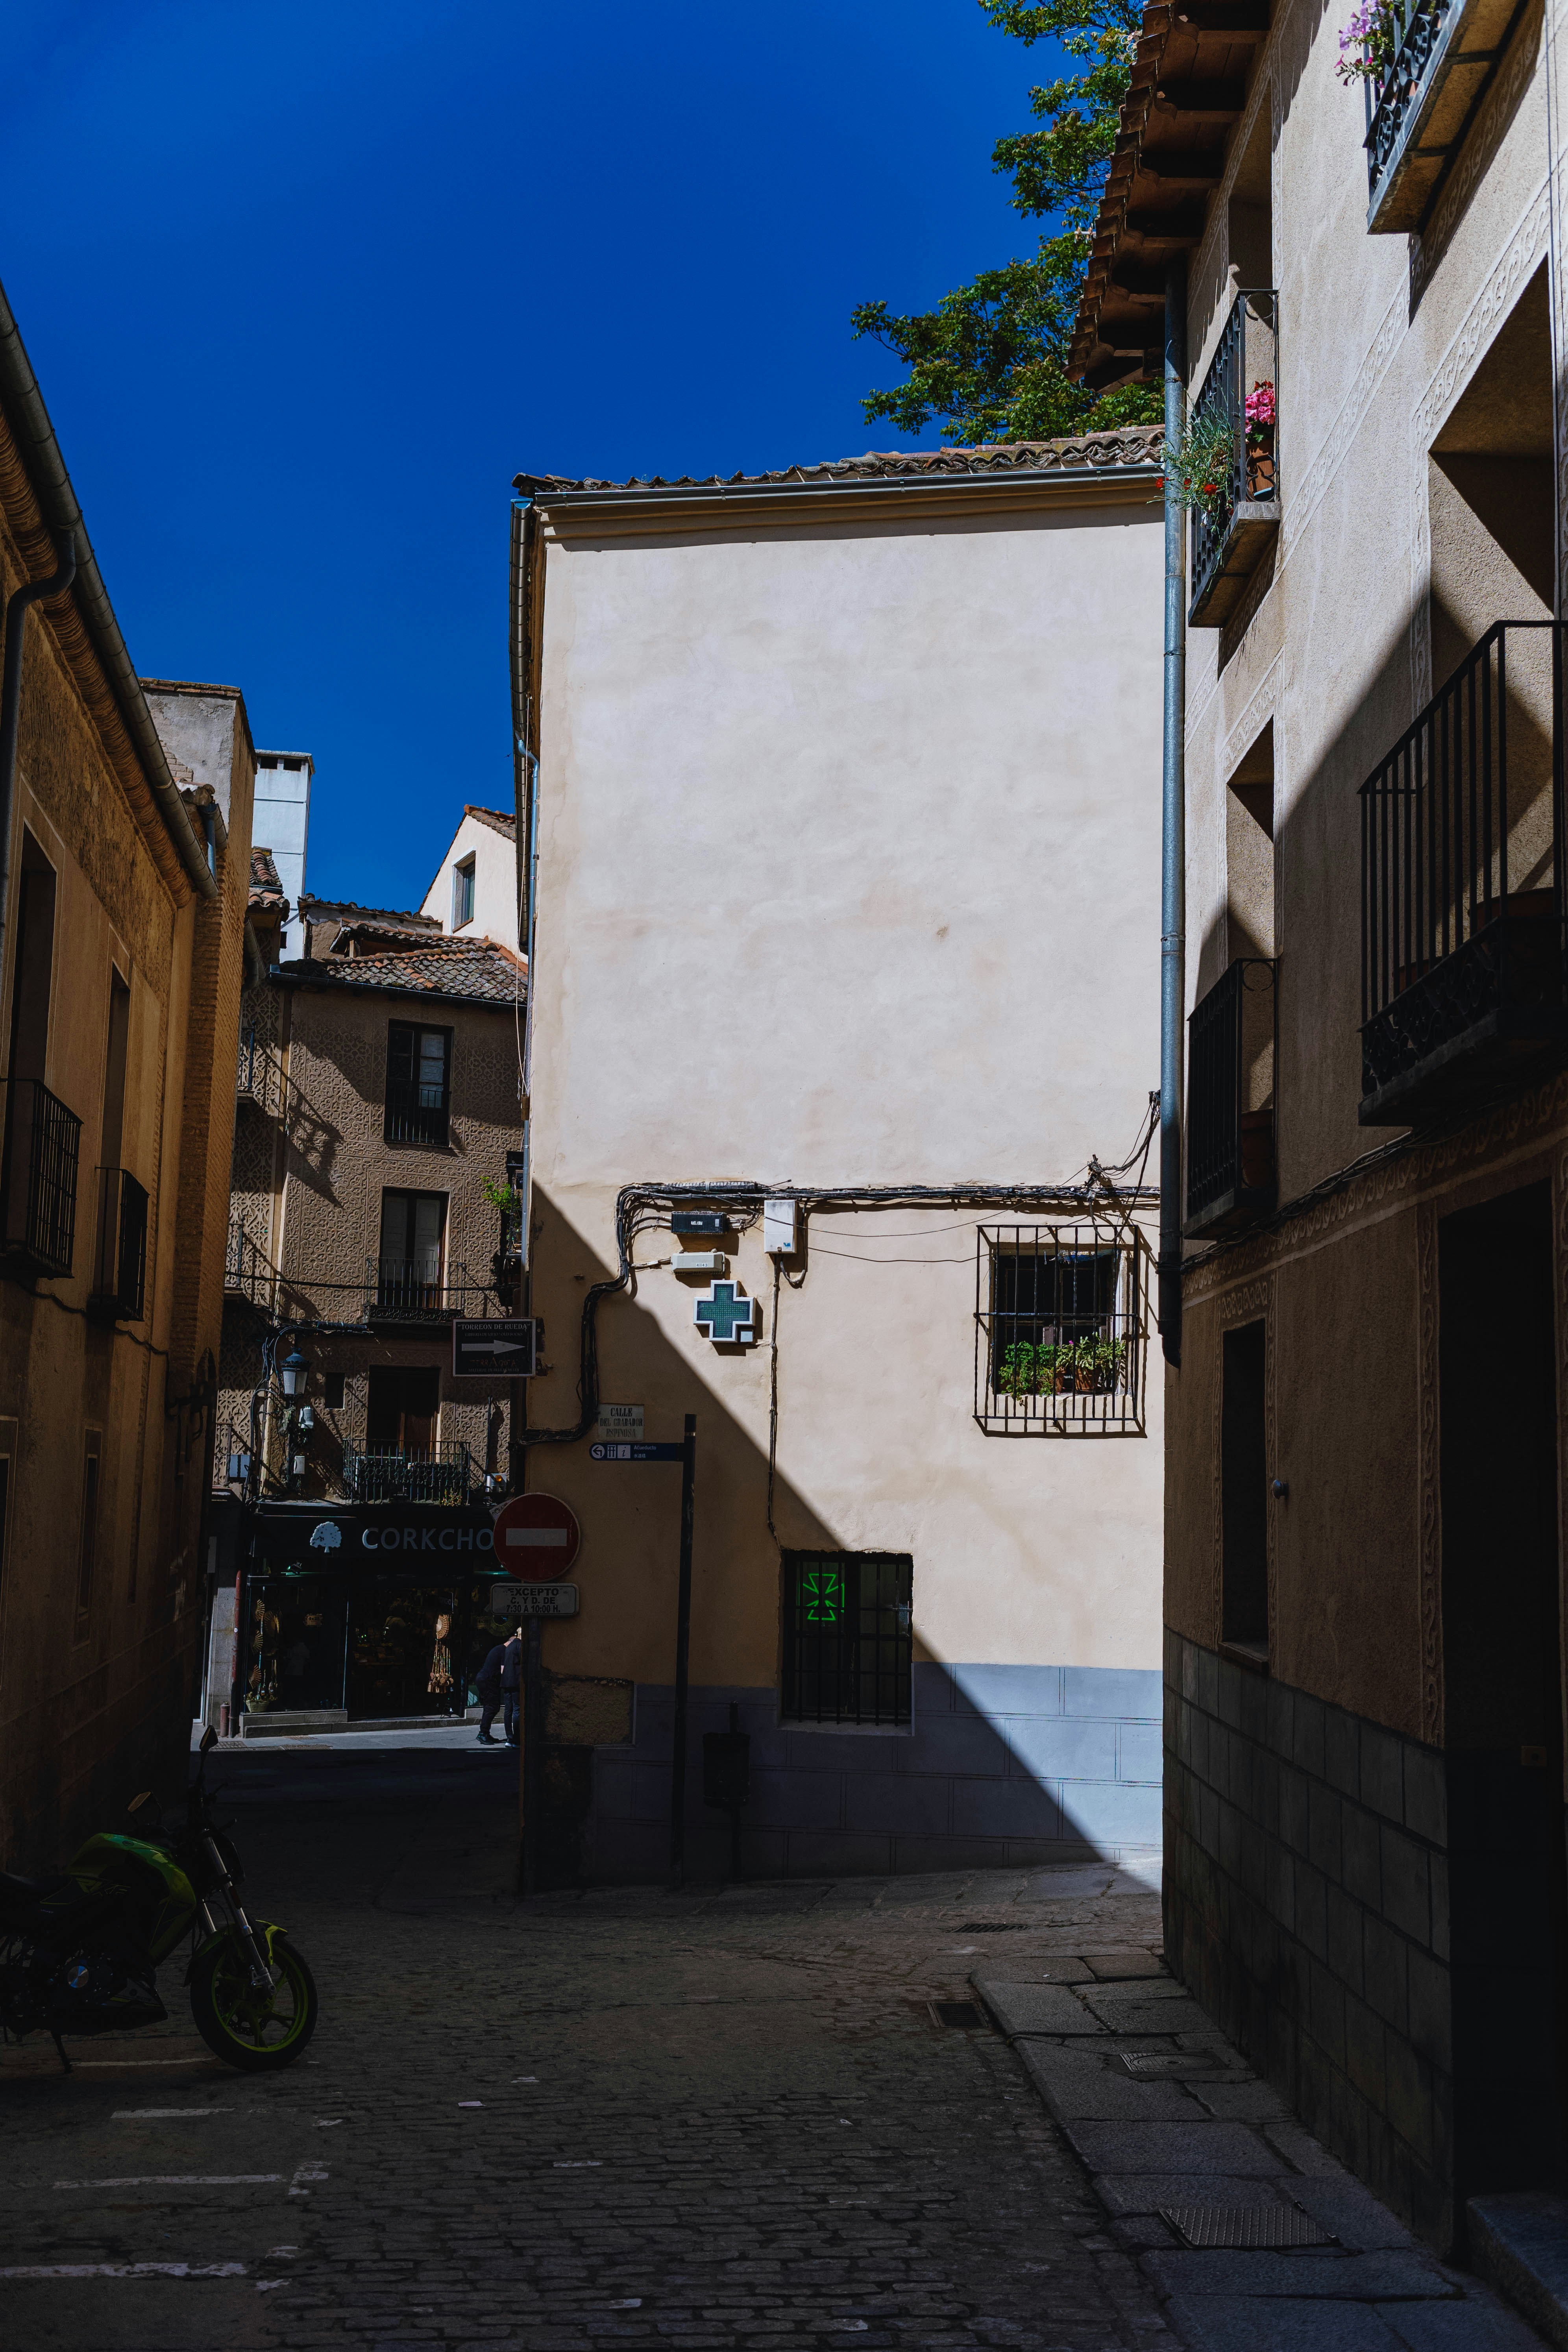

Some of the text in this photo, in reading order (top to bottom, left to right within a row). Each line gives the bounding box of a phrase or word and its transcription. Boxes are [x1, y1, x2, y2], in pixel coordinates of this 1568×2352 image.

[610, 1407, 632, 1416] CALLE
[600, 1418, 643, 1426] DEL GRABADOR
[606, 1429, 636, 1437] ESPINOSA
[362, 1527, 494, 1550] CORKCHO
